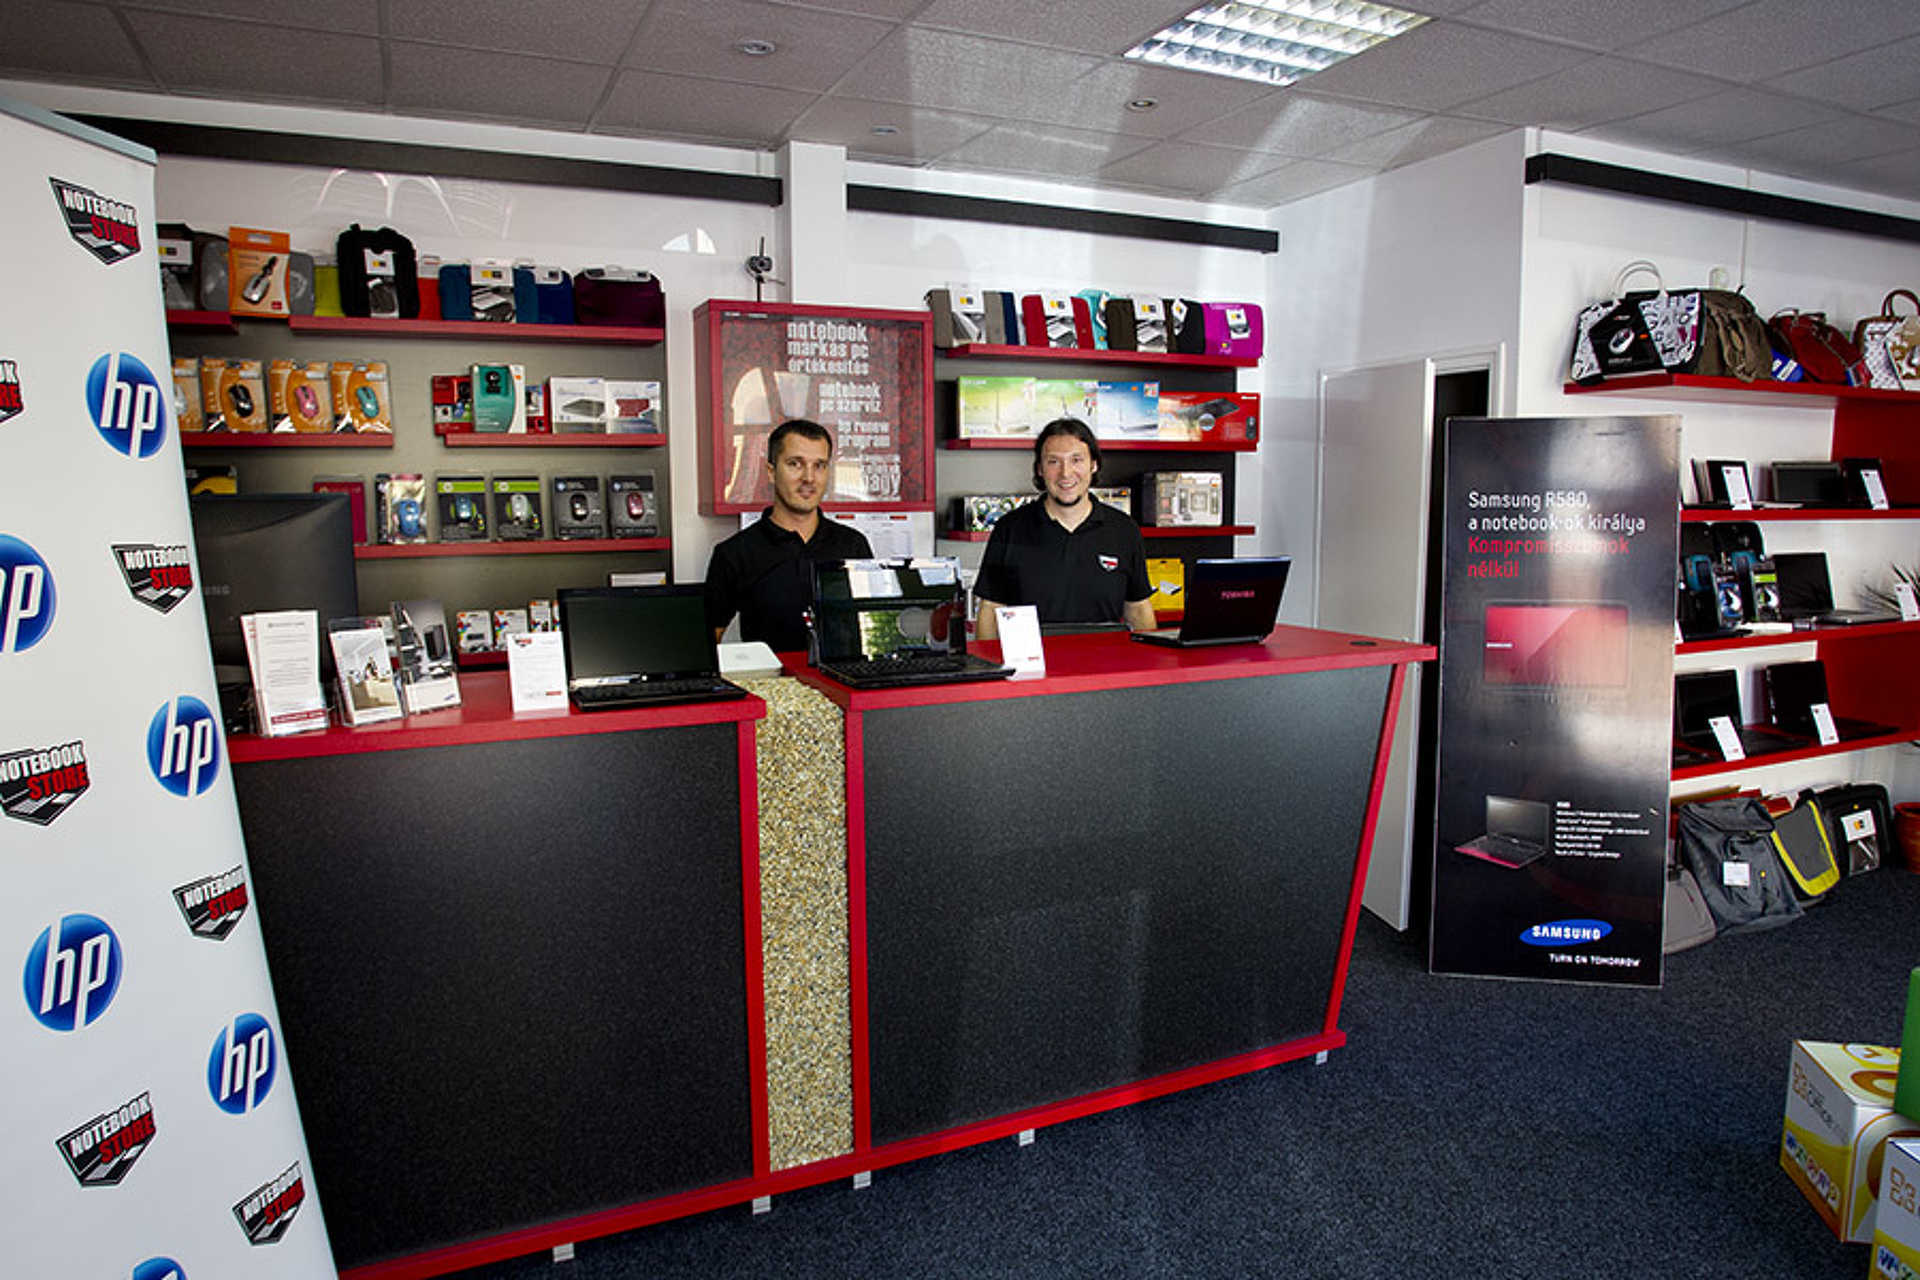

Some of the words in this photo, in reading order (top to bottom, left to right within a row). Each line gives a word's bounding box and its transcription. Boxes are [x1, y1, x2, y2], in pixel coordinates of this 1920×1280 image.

[787, 320, 868, 343] notebook
[101, 353, 157, 458] hp
[1468, 490, 1542, 513] Samsung
[1545, 490, 1591, 510] R580,
[1467, 517, 1478, 531] a
[1588, 514, 1646, 536] királya
[1468, 536, 1631, 558] Kompromissmok
[160, 698, 212, 796] hp
[27, 764, 88, 801] STORE
[1531, 925, 1601, 941] SAMSUNG
[41, 918, 110, 1030] hp
[1574, 955, 1588, 964] ON
[220, 1018, 269, 1113] hp
[70, 1094, 151, 1158] NOTEBOOK
[99, 1112, 155, 1164] STORE
